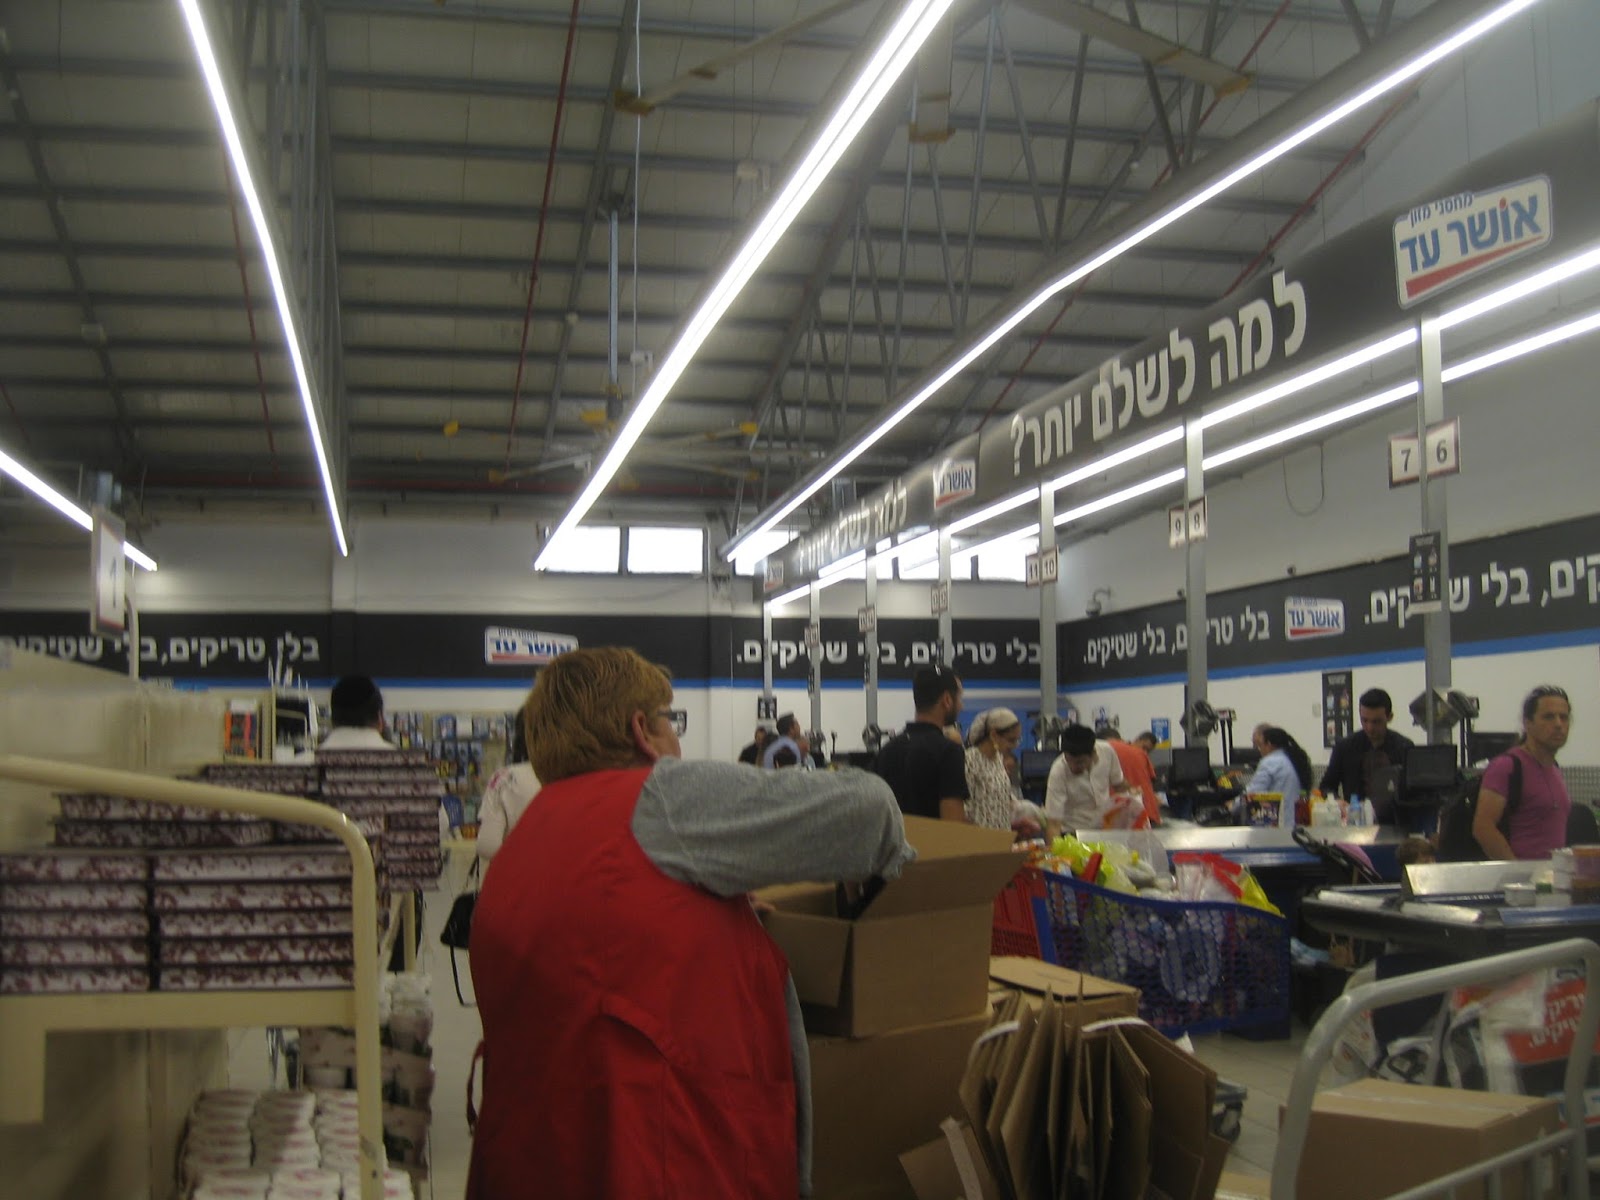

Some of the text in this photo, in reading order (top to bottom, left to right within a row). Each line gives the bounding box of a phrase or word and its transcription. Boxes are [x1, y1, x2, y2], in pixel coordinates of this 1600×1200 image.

[1410, 204, 1431, 228] מזון
[1400, 194, 1542, 274] אושר עד
[1010, 269, 1308, 478] למה לשלם יותר?
[1400, 438, 1448, 473] 7 6
[1481, 562, 1530, 608] בלי
[1288, 607, 1341, 629] אושר עד
[161, 636, 267, 668] טריקים,
[857, 640, 898, 666] בי
[1006, 637, 1041, 665] בלי
[1083, 605, 1270, 669] בלי טרים, בלי שטיקים.
[904, 641, 998, 669] טריים,
